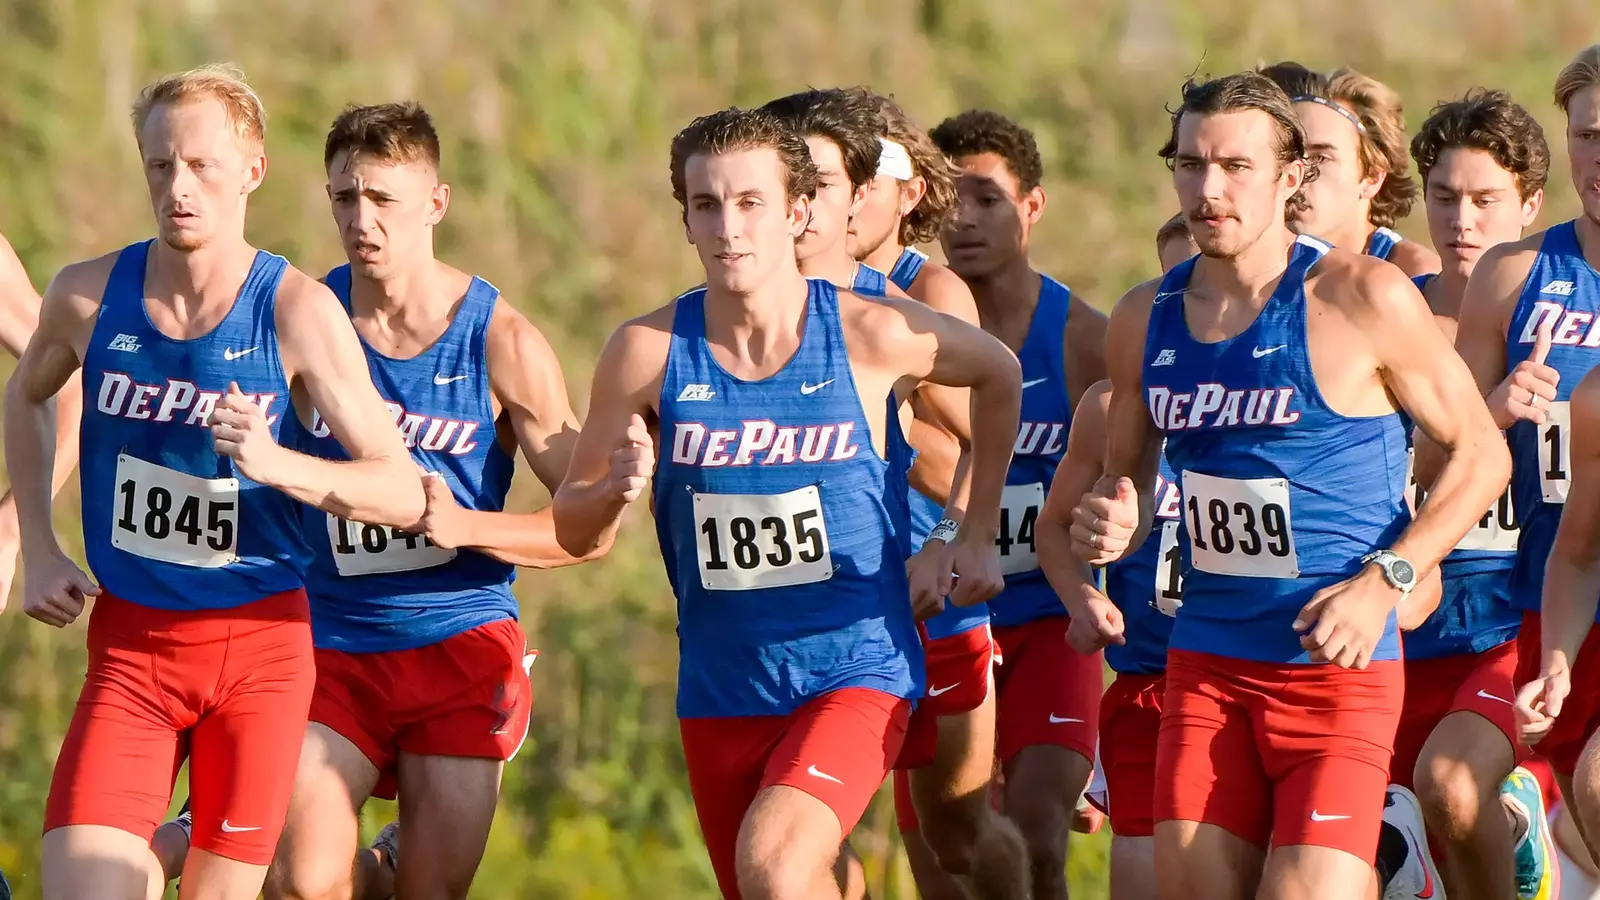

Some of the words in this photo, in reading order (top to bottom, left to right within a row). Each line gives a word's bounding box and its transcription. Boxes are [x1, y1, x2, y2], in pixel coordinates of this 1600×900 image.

[108, 340, 142, 352] EAST
[113, 333, 139, 344] BIG
[97, 371, 278, 429] DEPAL
[118, 479, 234, 552] 1845
[701, 509, 824, 570] 1835
[1188, 495, 1290, 557] 1839
